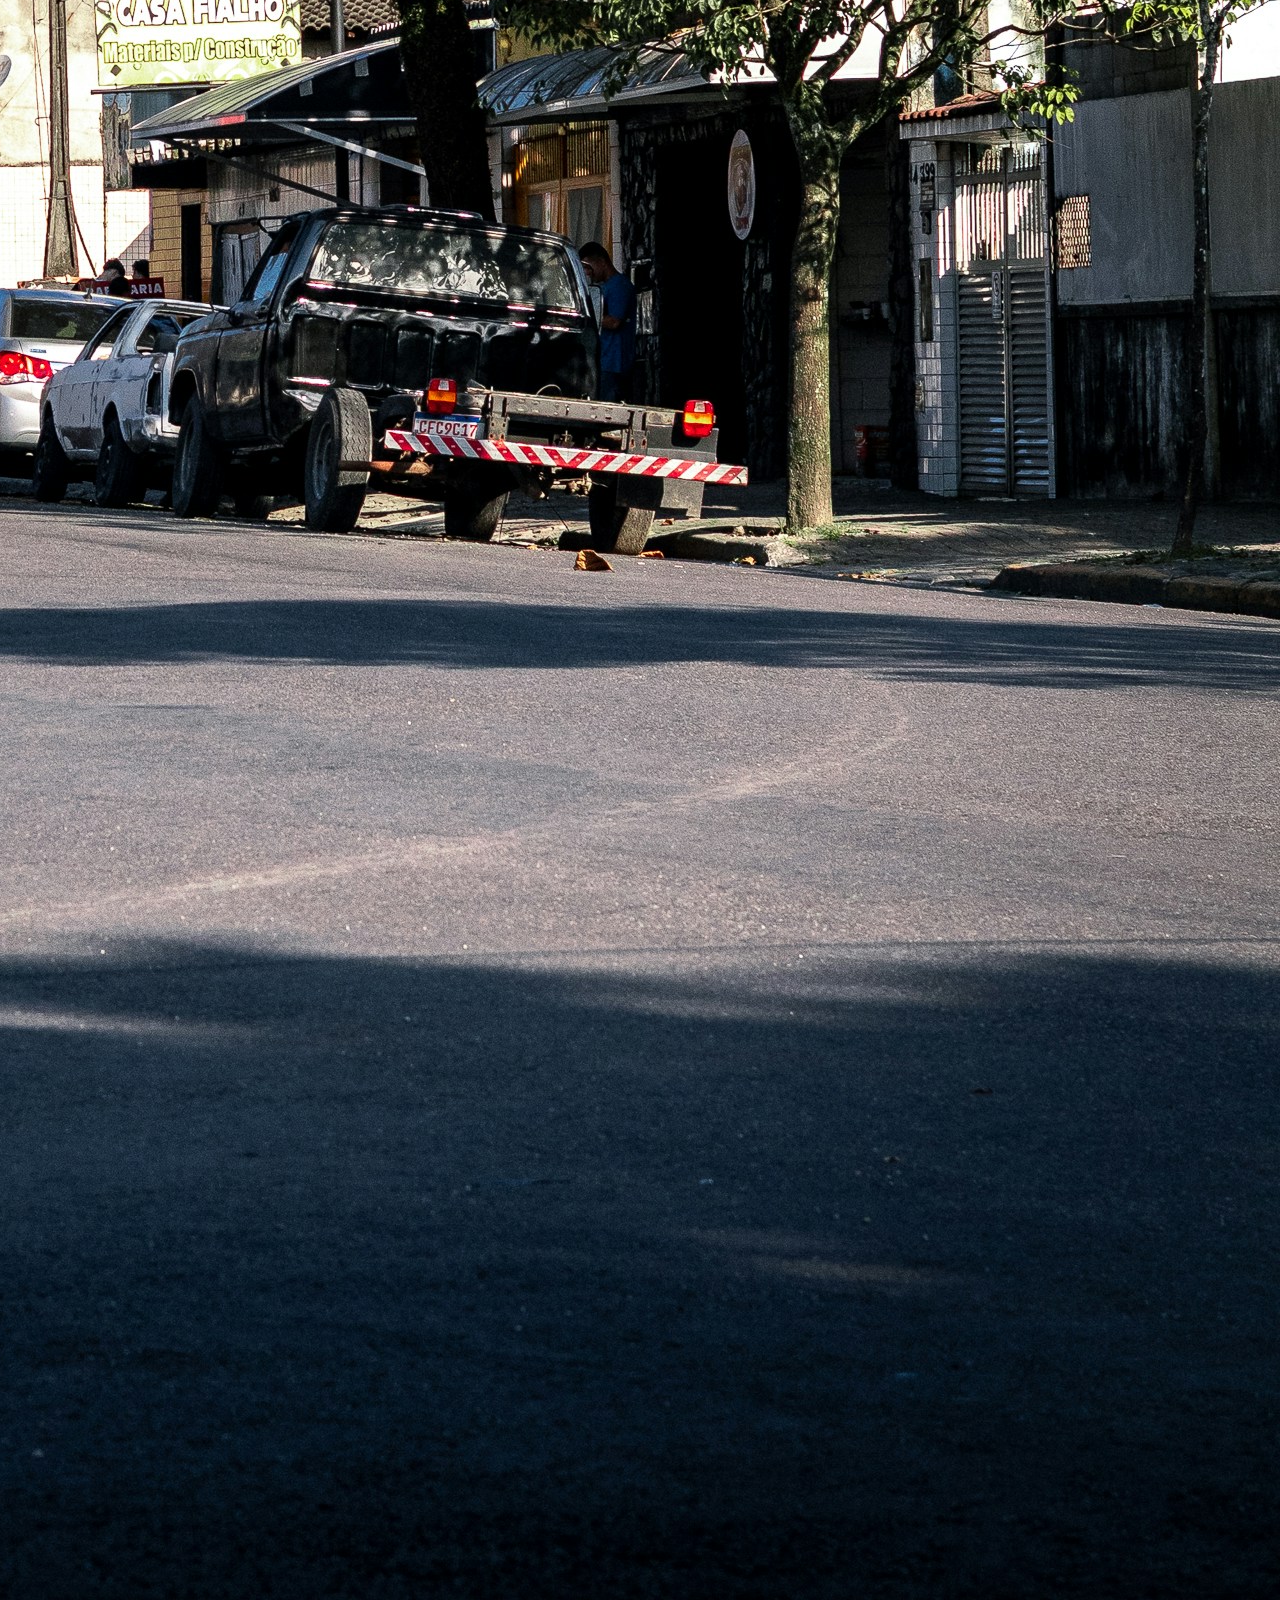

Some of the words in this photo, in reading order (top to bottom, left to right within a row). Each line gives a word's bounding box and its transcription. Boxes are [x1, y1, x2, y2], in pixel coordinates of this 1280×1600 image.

[103, 40, 181, 63] Materiais
[182, 38, 202, 62] p/
[204, 34, 296, 61] Construção
[419, 420, 478, 437] CFC9C17
